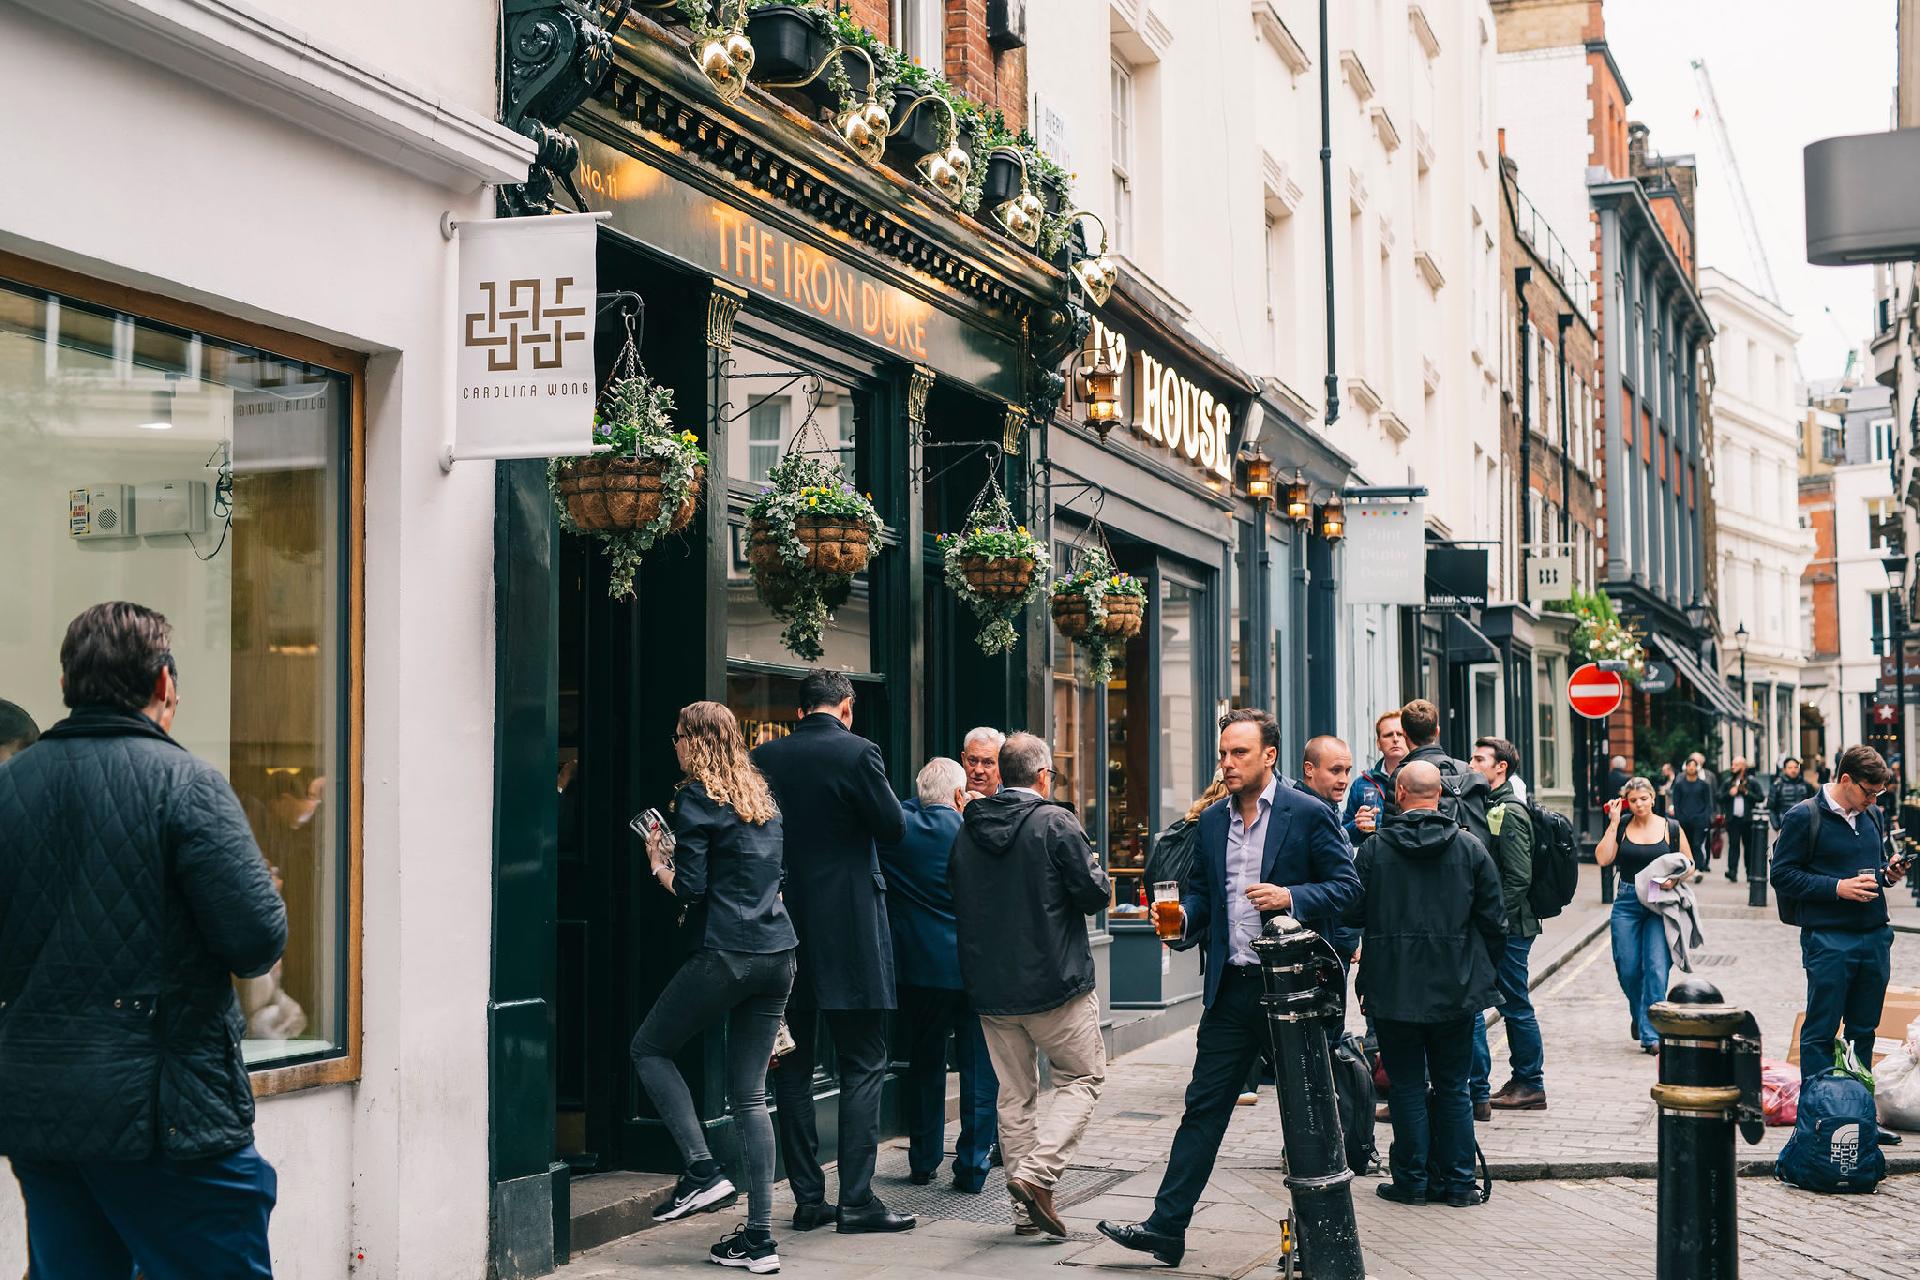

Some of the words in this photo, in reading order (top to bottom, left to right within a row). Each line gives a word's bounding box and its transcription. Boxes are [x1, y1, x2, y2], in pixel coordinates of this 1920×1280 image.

[580, 160, 605, 194] NO.
[606, 174, 617, 200] 11
[712, 206, 776, 293] THE
[783, 241, 856, 329] IRON
[862, 280, 928, 360] DUKE
[463, 384, 537, 400] CAROLINA
[547, 382, 588, 396] WONG
[1141, 349, 1231, 482] HOUSE
[1830, 1143, 1840, 1163] THE
[1849, 1143, 1859, 1170] FACE
